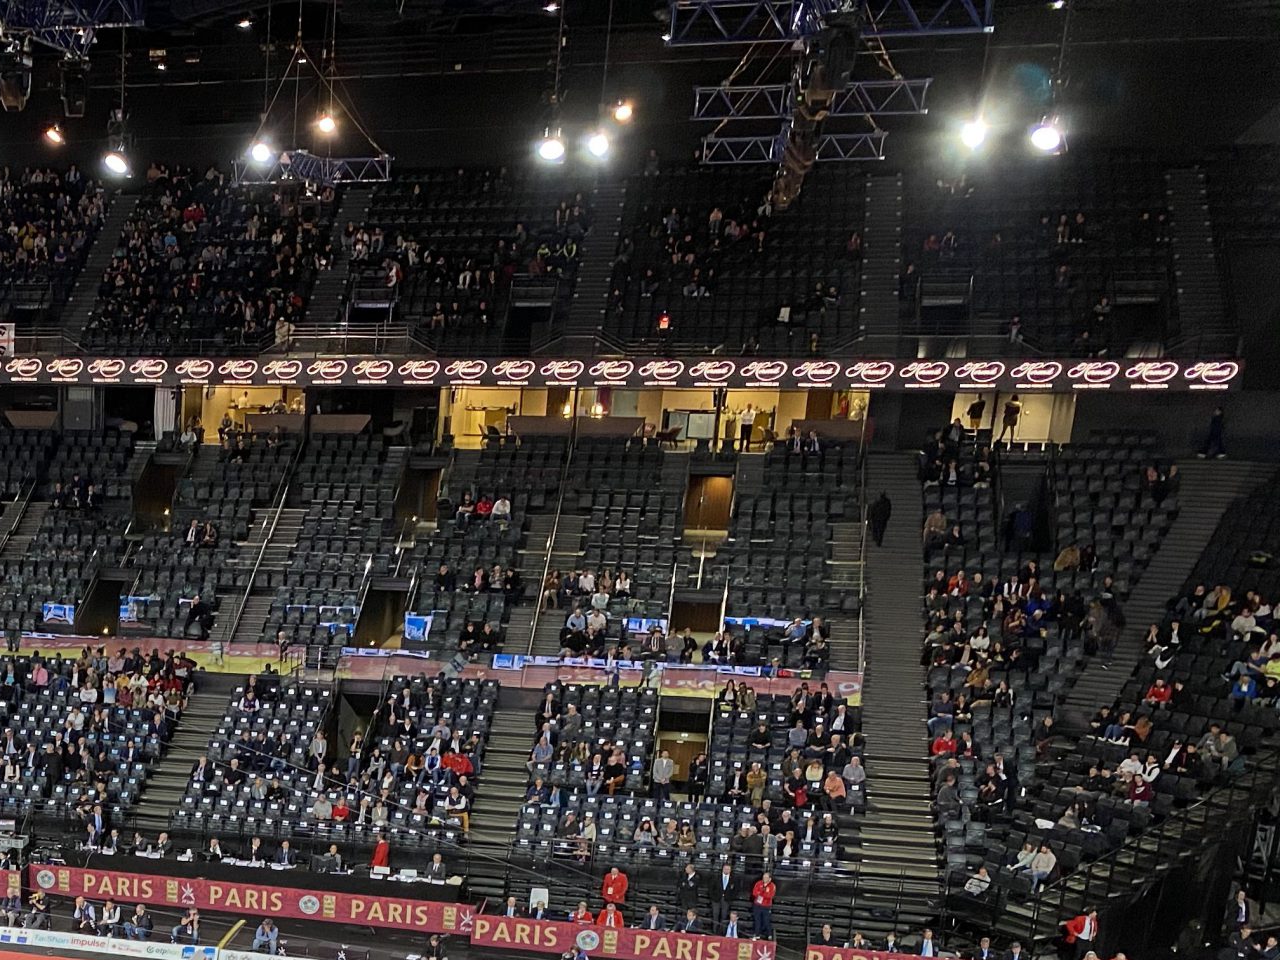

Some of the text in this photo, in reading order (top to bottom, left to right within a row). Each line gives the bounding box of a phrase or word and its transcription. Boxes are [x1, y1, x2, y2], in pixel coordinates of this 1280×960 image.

[83, 873, 153, 898] PARIS
[209, 885, 282, 912] PARIS
[350, 899, 428, 926] PARIS
[33, 933, 70, 945] TaiShan
[71, 936, 106, 948] impulse
[474, 919, 558, 947] PARIS
